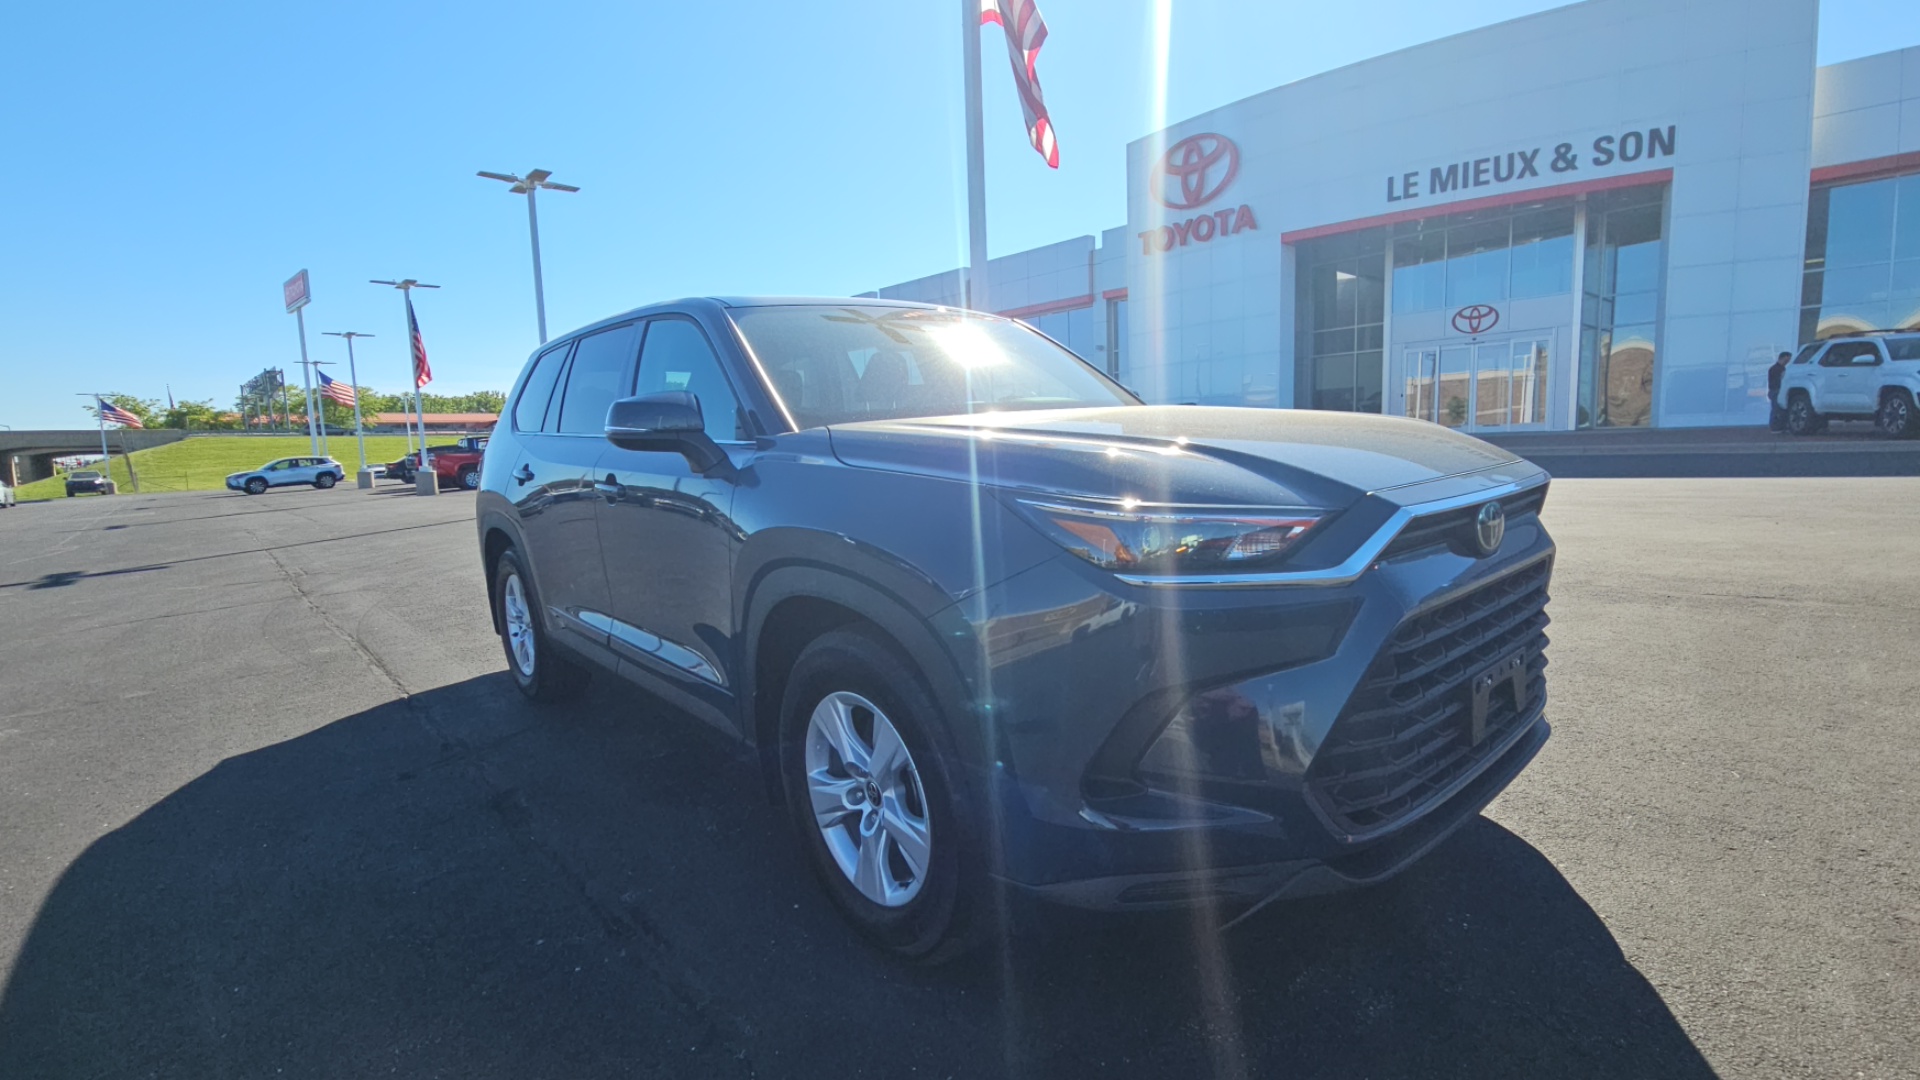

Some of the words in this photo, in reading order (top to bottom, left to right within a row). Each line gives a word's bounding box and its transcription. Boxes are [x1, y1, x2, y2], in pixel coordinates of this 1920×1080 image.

[1387, 171, 1419, 202] LE
[1429, 148, 1541, 195] MIEUX
[1550, 142, 1578, 173] &
[1592, 125, 1676, 167] SON
[1138, 204, 1258, 256] TOYOTA
